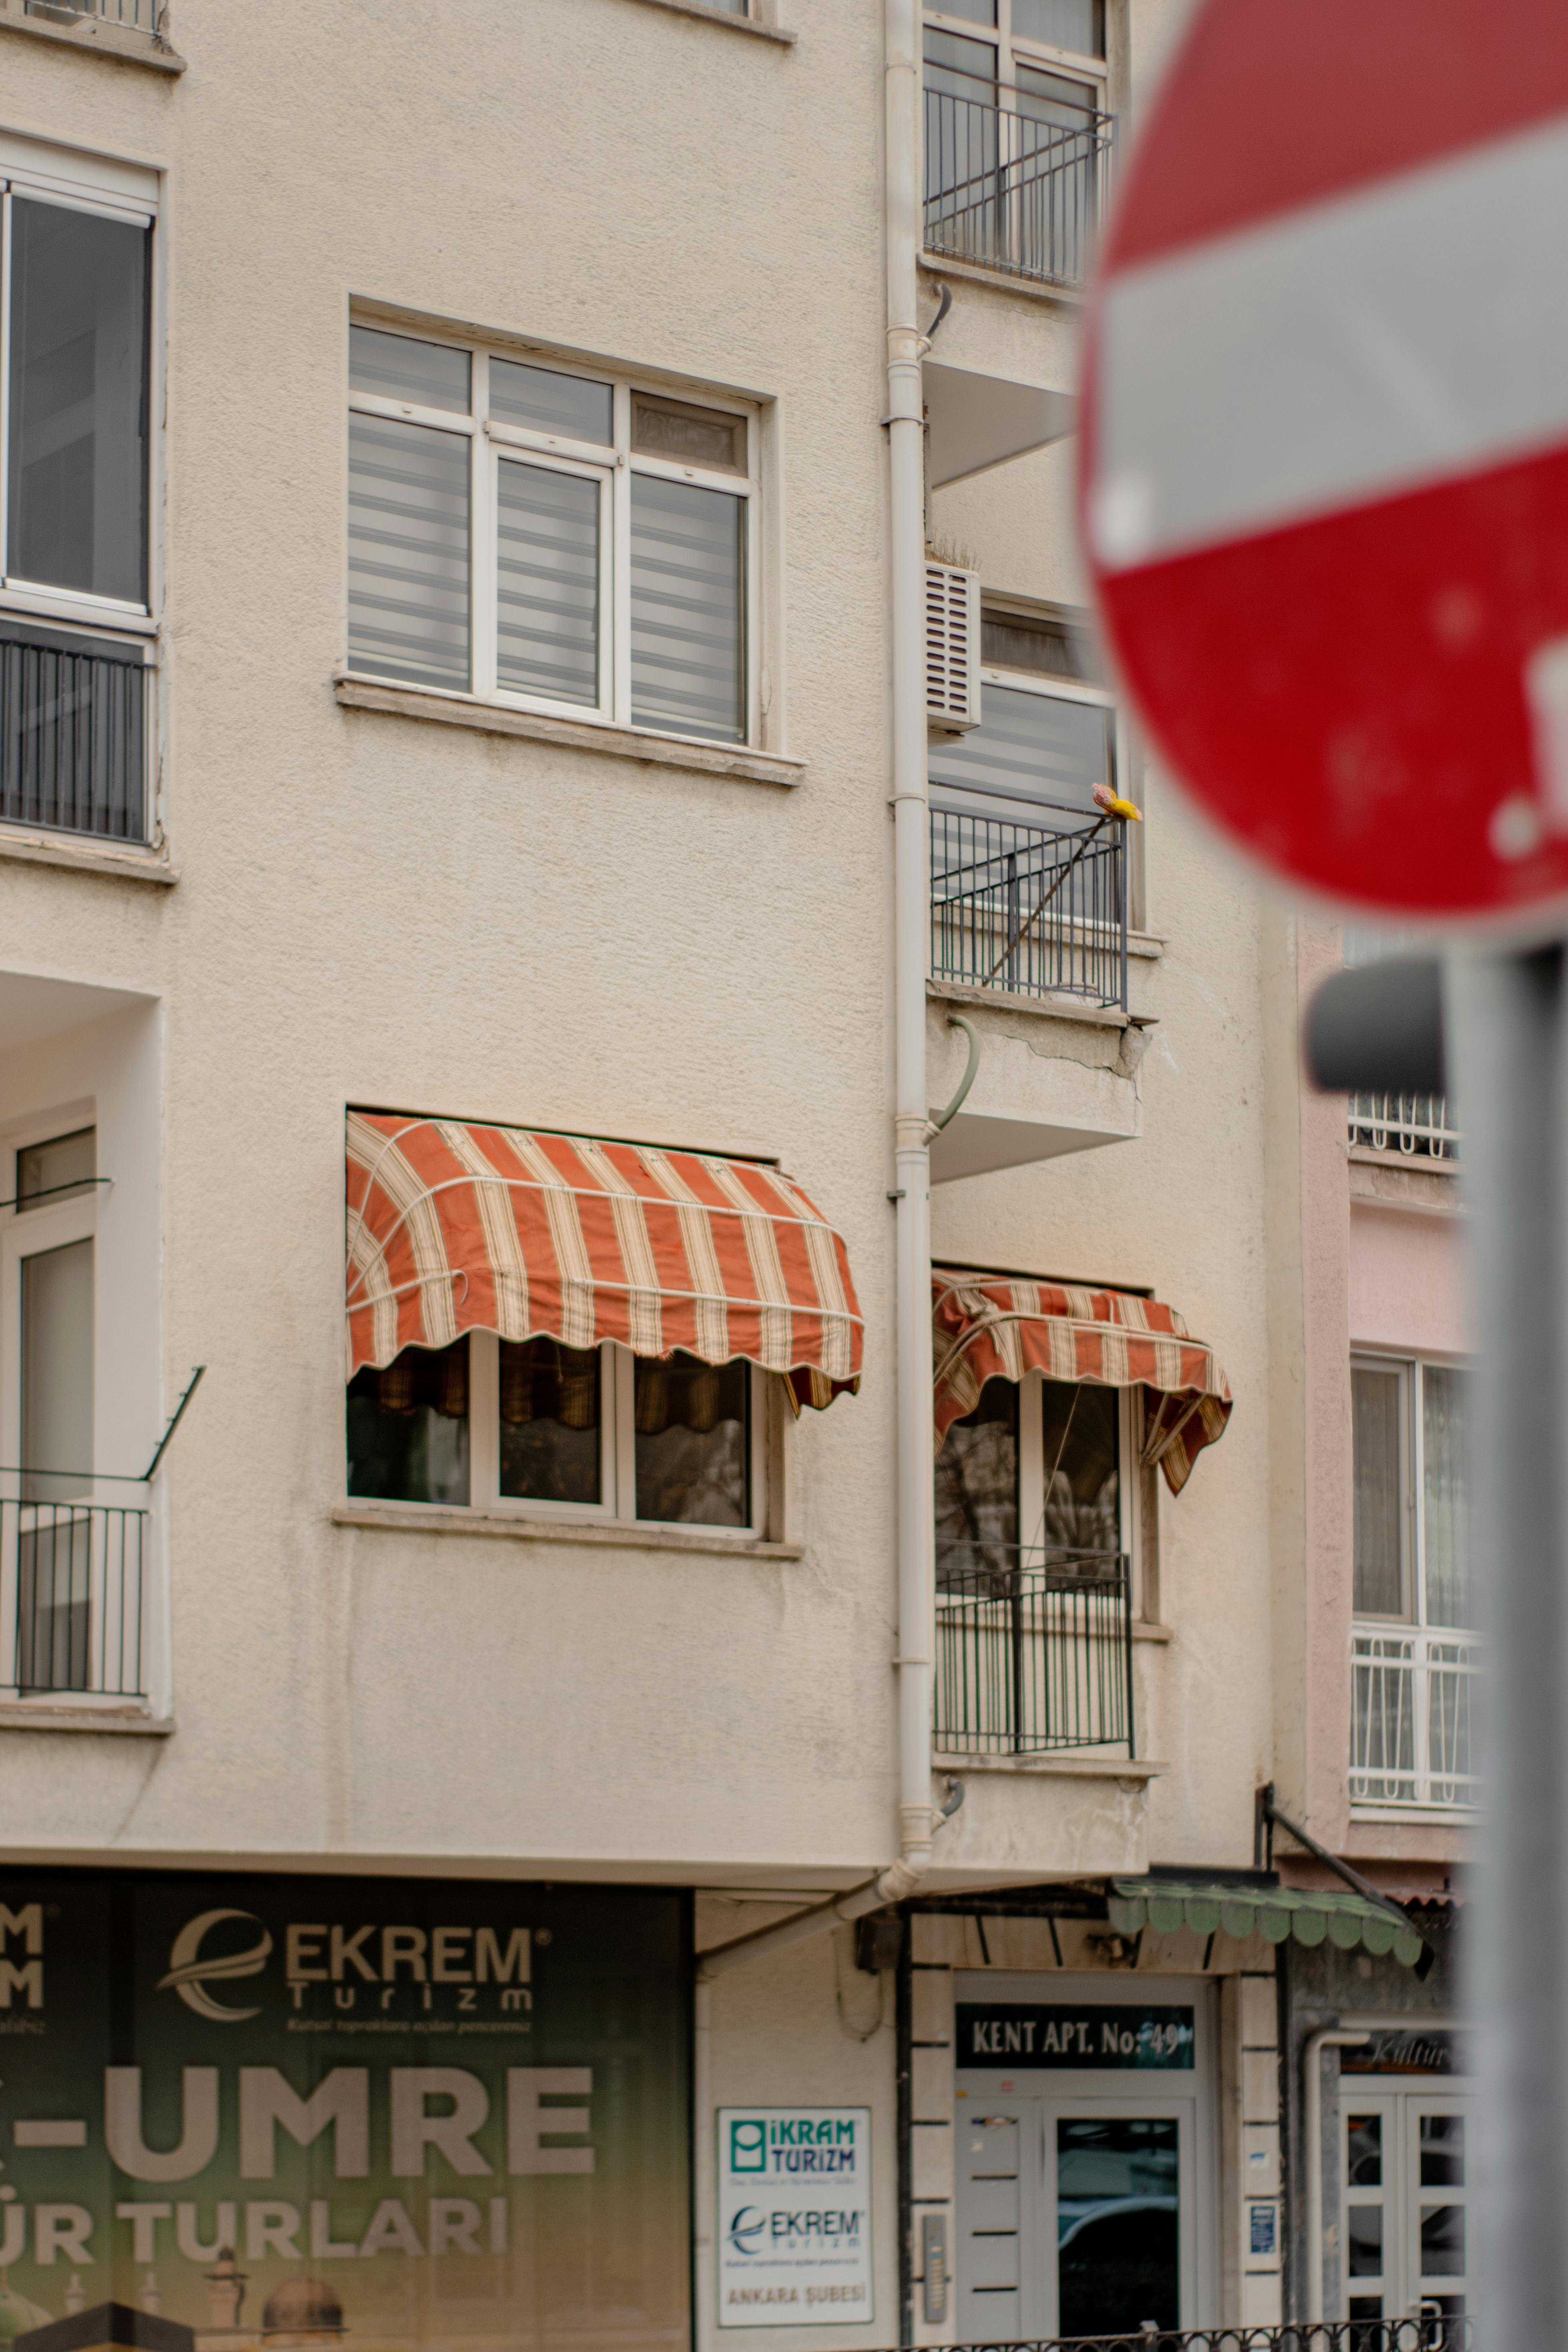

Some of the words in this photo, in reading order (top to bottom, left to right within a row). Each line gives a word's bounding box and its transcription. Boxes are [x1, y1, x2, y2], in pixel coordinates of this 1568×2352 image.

[286, 1924, 531, 1983] EKREM
[287, 1981, 533, 2010] Turizm
[973, 2021, 1036, 2053] KENT
[1043, 2022, 1093, 2053] APT.
[1149, 2024, 1178, 2055] 49
[0, 2066, 595, 2182] -UMRE
[116, 2197, 508, 2264] TURLARI
[771, 2210, 859, 2236] EKREM
[728, 2286, 799, 2305] ANKARA
[806, 2282, 865, 2307] ŞUBESİ
